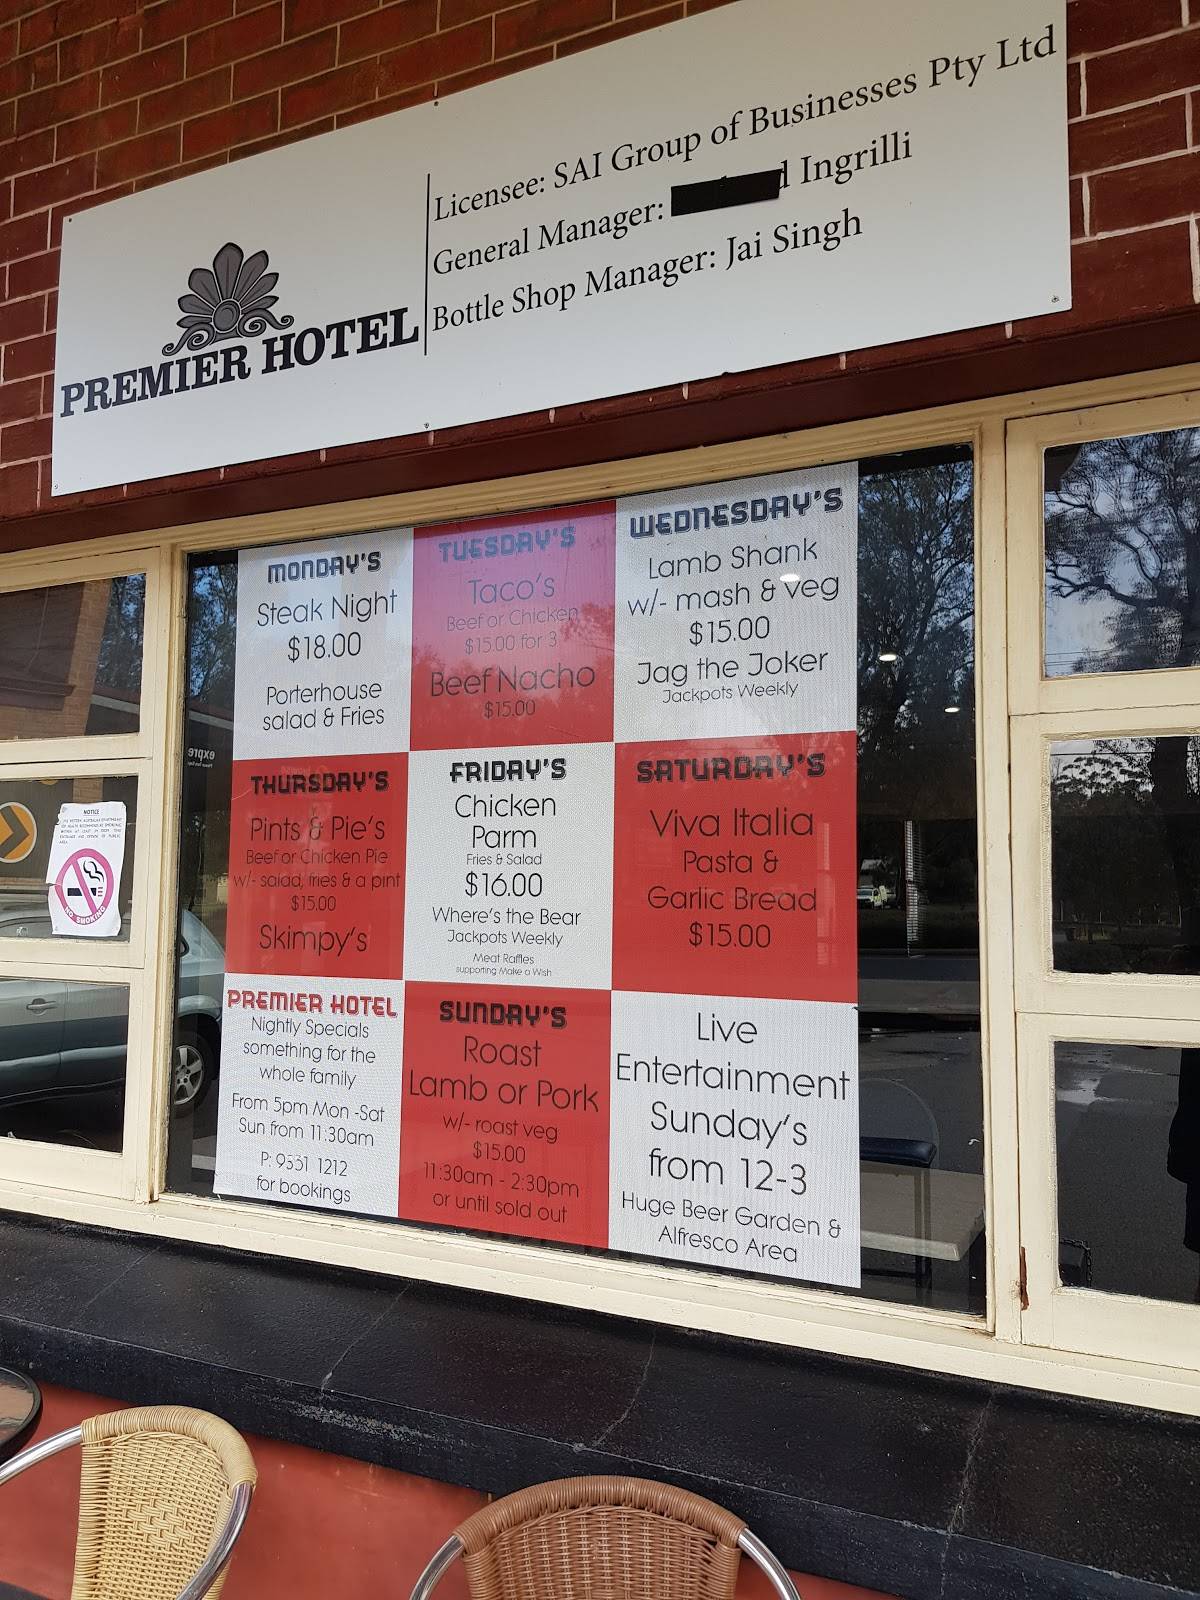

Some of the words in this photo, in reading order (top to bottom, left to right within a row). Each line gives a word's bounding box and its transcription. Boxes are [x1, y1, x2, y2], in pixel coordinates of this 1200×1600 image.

[434, 174, 546, 222] Licensee:
[554, 152, 602, 189] SAI
[611, 132, 701, 173] Group
[711, 112, 743, 145] of
[750, 73, 917, 136] Businesses
[929, 49, 986, 87] Pty
[996, 25, 1056, 69] Ltd
[434, 228, 530, 276] General
[538, 198, 664, 250] Manager:
[801, 132, 912, 186] Ingrilli
[433, 295, 504, 332] Bottle
[512, 278, 576, 317] Shop
[585, 249, 717, 296] Manager:
[725, 232, 763, 272] Jai
[773, 209, 863, 255] Singh
[60, 345, 251, 418] PREMIER
[261, 307, 419, 375] HOTEL
[630, 487, 843, 539] WEDNESDAY'S
[439, 526, 576, 563] TUESDAY'S
[649, 551, 721, 579] Lamb
[731, 538, 818, 569] Shank
[268, 551, 382, 584] MONDAY'S
[468, 571, 555, 605] Taco's
[628, 588, 667, 616] w/-
[676, 583, 749, 611] mash
[761, 579, 776, 602] &
[784, 576, 839, 601] veg
[257, 598, 323, 627] Steak
[332, 589, 398, 622] Night
[447, 613, 483, 632] Beef
[486, 613, 504, 629] or
[509, 605, 578, 625] Chicken
[465, 634, 515, 655] $15.00
[521, 634, 543, 649] for
[548, 631, 557, 647] 3
[689, 616, 770, 646] $15.00
[287, 632, 362, 663] $18.00
[430, 668, 492, 698] Beef
[498, 663, 595, 693] Nacho
[637, 662, 688, 688] Jag
[697, 658, 739, 679] the
[748, 651, 828, 677] Joker
[267, 682, 383, 706] Porterhouse
[662, 686, 733, 704] Jackpots
[738, 682, 799, 698] Weekly
[263, 708, 316, 731] salad
[324, 706, 335, 727] &
[341, 704, 385, 727] Fries
[483, 700, 536, 719] $15.00
[450, 758, 566, 783] FRIDAY'S
[637, 753, 826, 783] SATURDAY'S
[250, 771, 389, 795] THURSDAY'S
[455, 794, 556, 817] Chicken
[250, 818, 300, 841] Pints
[309, 817, 323, 839] &
[332, 815, 385, 840] Pie's
[472, 826, 536, 848] Parm
[649, 809, 720, 837] Viva
[733, 808, 814, 837] Italia
[246, 850, 277, 864] Beef
[282, 850, 296, 864] or
[300, 849, 361, 864] Chicken
[366, 849, 388, 863] Pie
[466, 854, 492, 865] Fries
[496, 854, 502, 865] &
[507, 853, 542, 865] Salad
[684, 850, 752, 873] Pasta
[763, 850, 778, 872] &
[233, 871, 255, 889] w/-
[260, 875, 303, 889] salad,
[309, 874, 337, 887] fries
[342, 873, 350, 888] &
[356, 876, 365, 888] a
[372, 875, 400, 891] pint
[465, 871, 543, 897] $16.00
[291, 896, 336, 911] $15.00
[647, 886, 724, 910] Garlic
[734, 887, 817, 911] Bread
[65, 907, 74, 918] NO
[76, 906, 106, 924] SMOKING
[432, 906, 500, 924] Where's
[506, 908, 534, 924] the
[540, 908, 581, 926] Bear
[259, 924, 367, 957] Skimpy's
[448, 929, 507, 945] Jackpots
[512, 931, 563, 947] Weekly
[689, 922, 771, 948] $15.00
[456, 966, 496, 976] supporting
[499, 967, 522, 976] Make
[533, 968, 552, 977] Wish
[473, 953, 500, 963] Meat
[503, 954, 534, 965] Raffles
[227, 989, 323, 1014] PREMIER
[330, 994, 398, 1018] HOTEL
[440, 1000, 567, 1029] SUNDAY'S
[252, 1016, 301, 1036] Nightly
[306, 1018, 369, 1039] Specials
[698, 1012, 757, 1043] Live
[243, 1041, 322, 1063] something
[327, 1045, 346, 1060] for
[351, 1047, 376, 1064] the
[464, 1035, 542, 1067] Roast
[260, 1066, 305, 1083] whole
[310, 1068, 356, 1090] family
[410, 1069, 488, 1101] Lamb
[498, 1083, 527, 1105] or
[537, 1080, 599, 1112] Pork
[617, 1053, 850, 1100] Entertainment
[232, 1093, 268, 1112] From
[273, 1097, 308, 1116] 5pm
[312, 1101, 348, 1119] Mon
[239, 1118, 265, 1135] Sun
[270, 1121, 304, 1139] from
[311, 1125, 374, 1147] 11:30am
[442, 1112, 470, 1132] w/-
[475, 1119, 518, 1136] roast
[522, 1123, 558, 1144] veg
[651, 1101, 807, 1149] Sunday's
[261, 1152, 271, 1168] P:
[318, 1158, 348, 1177] 1212
[473, 1141, 525, 1164] $15.00
[424, 1162, 493, 1187] 11:30am
[511, 1173, 579, 1199] 2:30pm
[649, 1148, 724, 1185] from
[741, 1158, 807, 1195] 12-3
[257, 1175, 275, 1191] for
[279, 1179, 351, 1205] bookings
[433, 1192, 451, 1206] or
[455, 1195, 489, 1213] until
[495, 1201, 531, 1218] sold
[537, 1205, 568, 1223] out
[622, 1191, 675, 1217] Huge
[682, 1199, 729, 1221] Beer
[735, 1206, 820, 1236] Garden
[828, 1220, 841, 1238] &
[658, 1225, 738, 1253] Alfresco
[745, 1238, 797, 1263] Area
